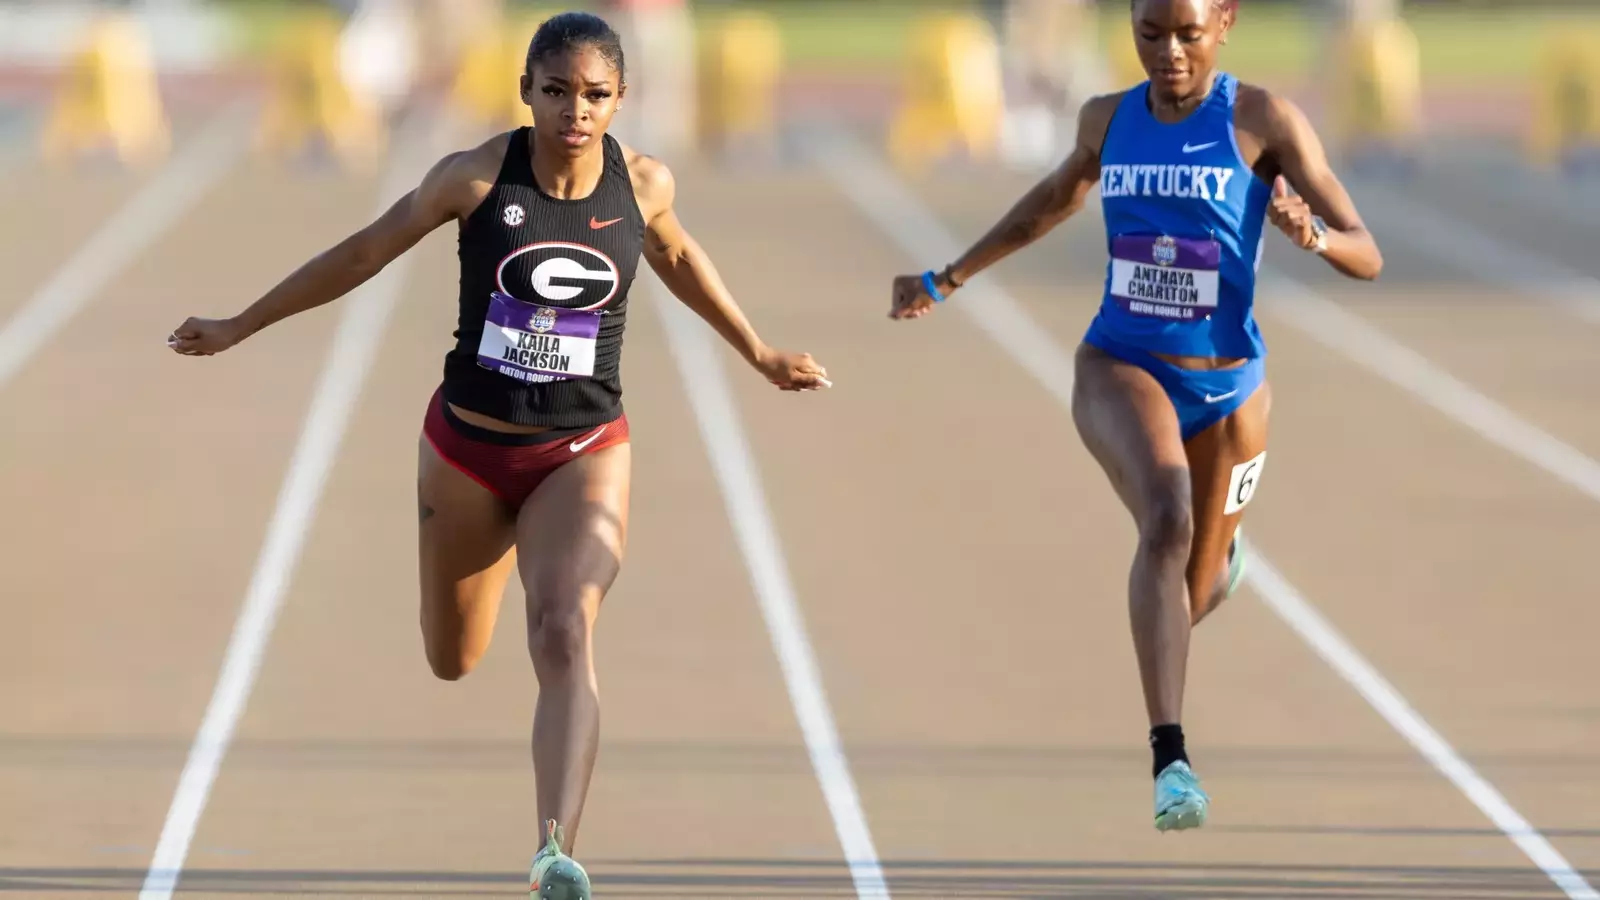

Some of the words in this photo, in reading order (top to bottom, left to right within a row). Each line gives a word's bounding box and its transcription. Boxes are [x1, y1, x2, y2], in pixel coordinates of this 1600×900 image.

[504, 205, 523, 225] SEC
[1133, 265, 1194, 286] ANTHAYA
[1128, 280, 1198, 303] CHARLTON
[517, 331, 560, 353] KAILA
[502, 345, 570, 371] JACKSON
[1237, 462, 1257, 504] 6
